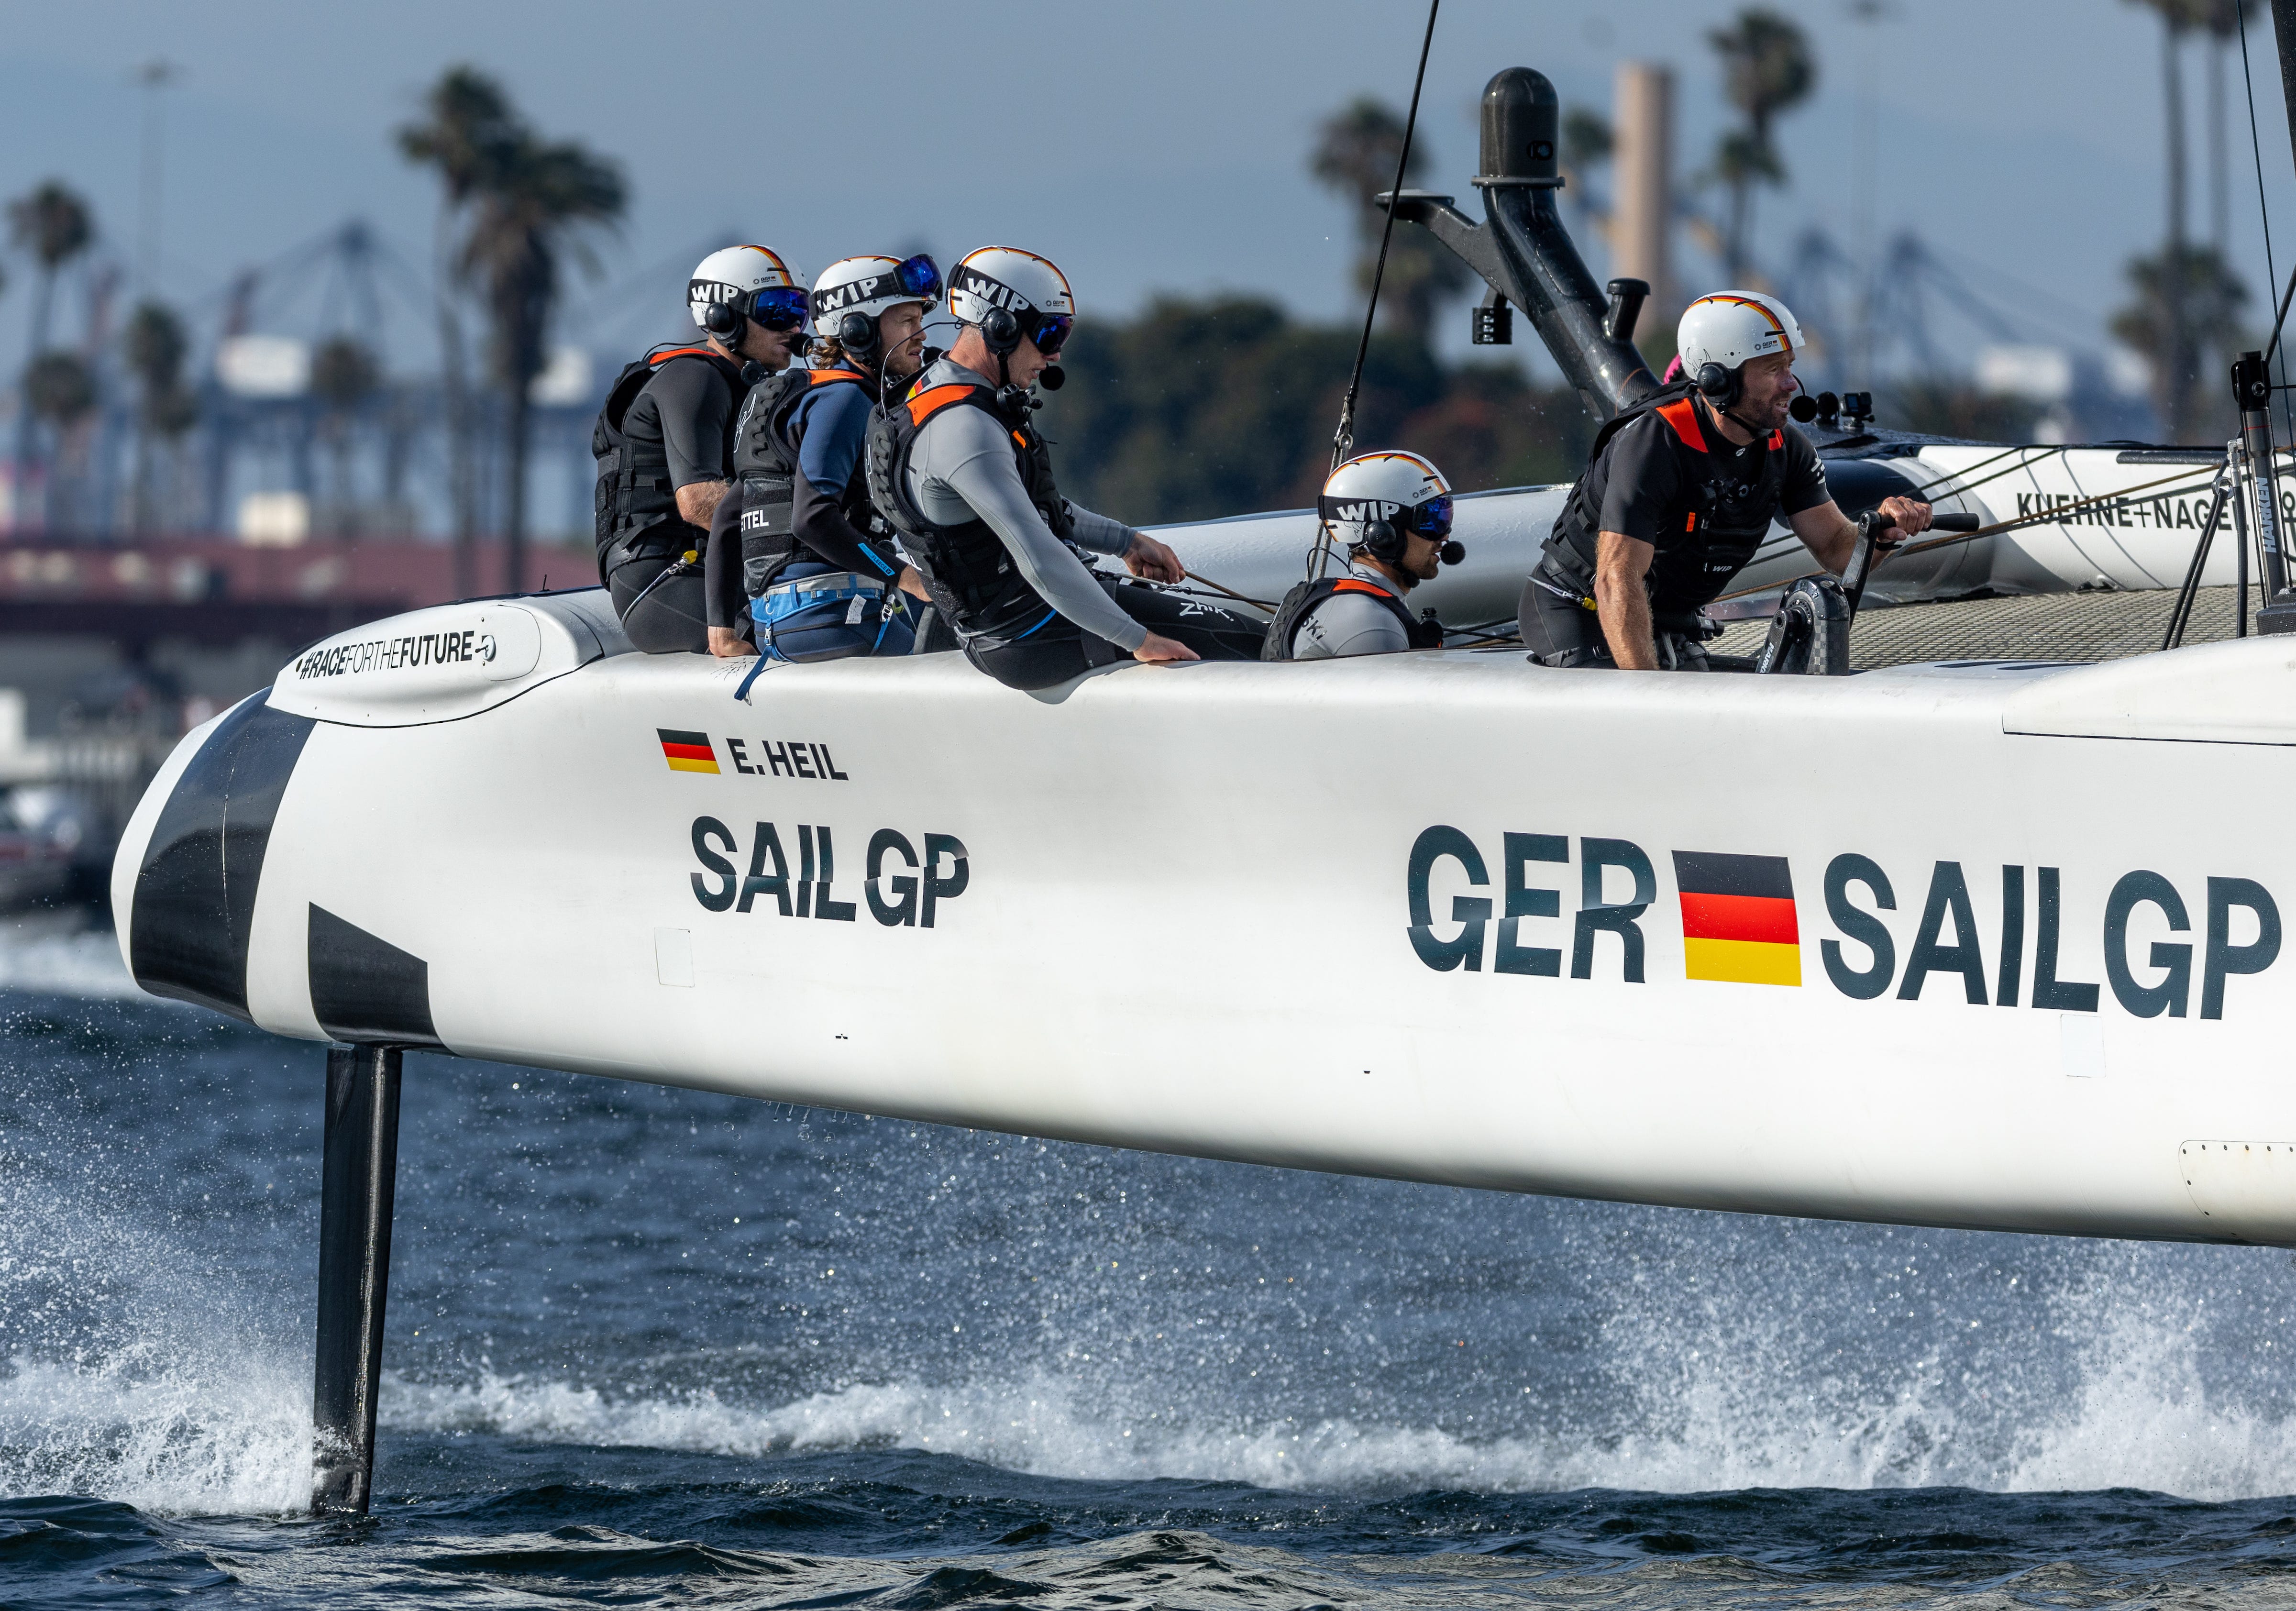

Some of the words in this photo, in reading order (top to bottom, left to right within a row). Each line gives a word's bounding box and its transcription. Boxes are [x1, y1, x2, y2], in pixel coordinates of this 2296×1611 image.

[691, 283, 738, 303] WIP
[817, 277, 878, 312] WIP
[967, 277, 1029, 312] WIP
[1336, 501, 1400, 521] WIP
[2254, 476, 2277, 553] HARKEN
[1179, 601, 1230, 619] Zhik
[299, 630, 475, 680] #RACEFORTHEFUTURE
[1760, 642, 1775, 674] HARK
[1406, 824, 1657, 983] GER
[1820, 852, 2282, 1020] SAILGP
